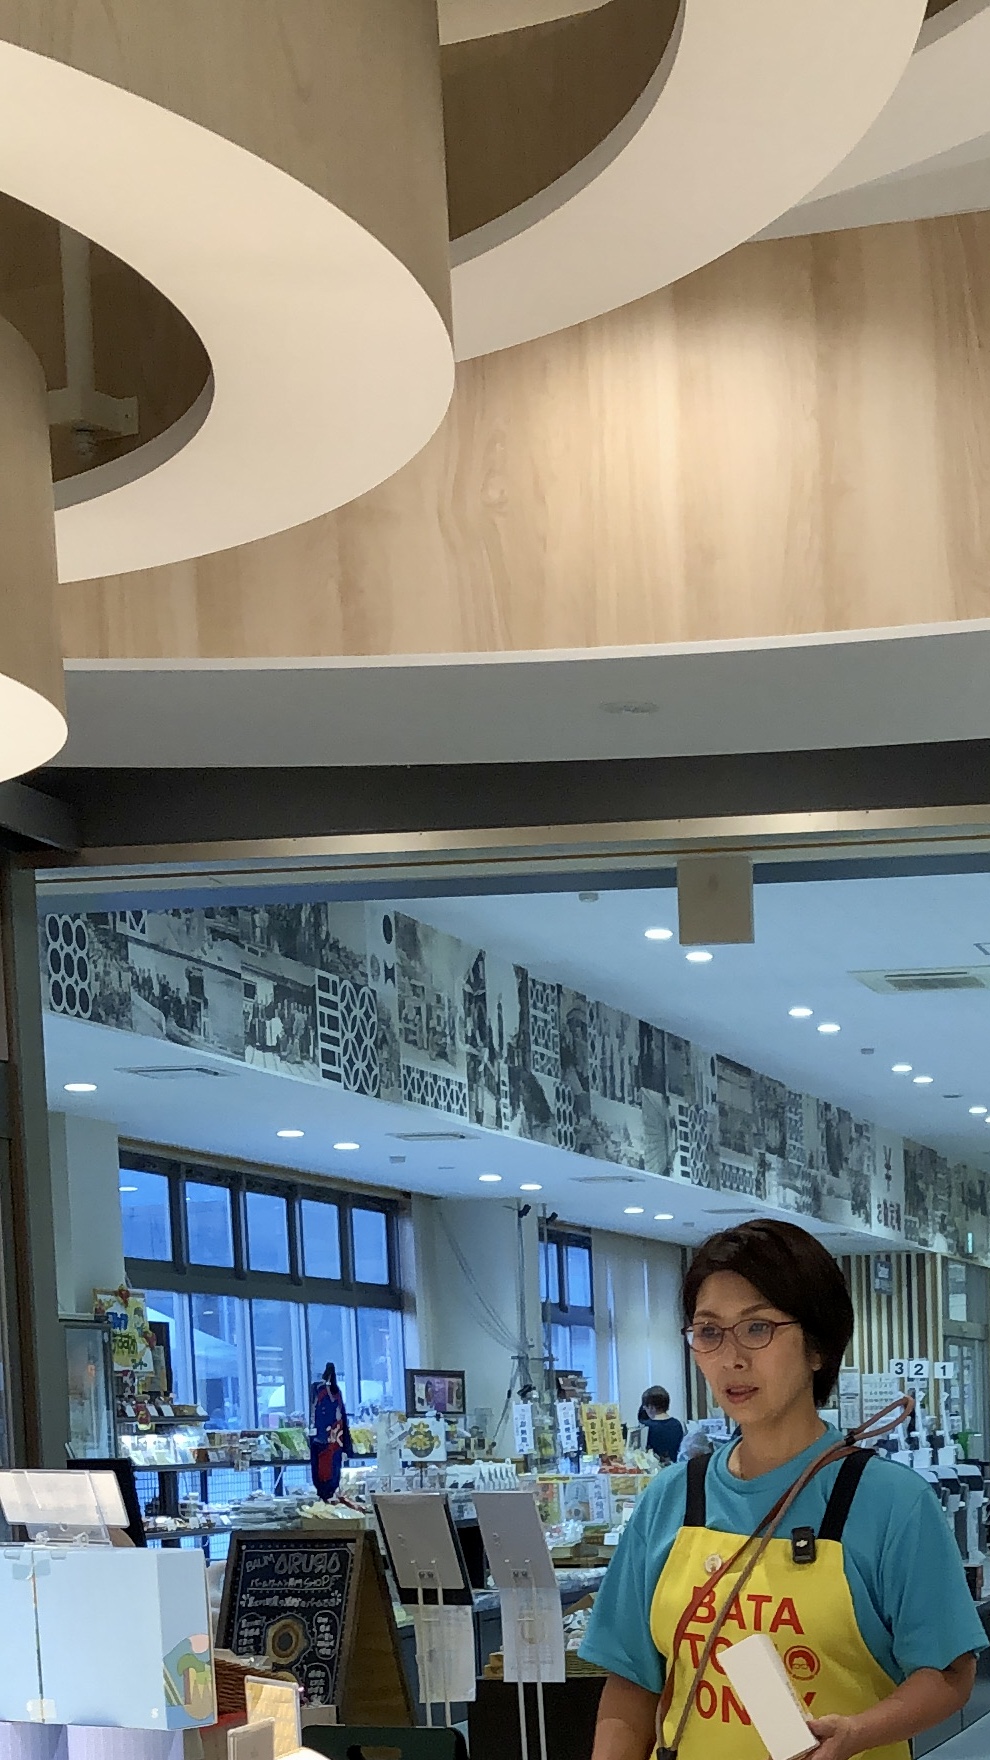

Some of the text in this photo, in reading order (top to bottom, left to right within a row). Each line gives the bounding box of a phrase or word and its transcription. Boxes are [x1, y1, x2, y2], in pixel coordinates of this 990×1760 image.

[894, 1362, 904, 1375] 3
[914, 1363, 924, 1376] 2
[940, 1364, 947, 1376] 1
[245, 1553, 275, 1573] BAUM
[689, 1586, 805, 1635] BATA
